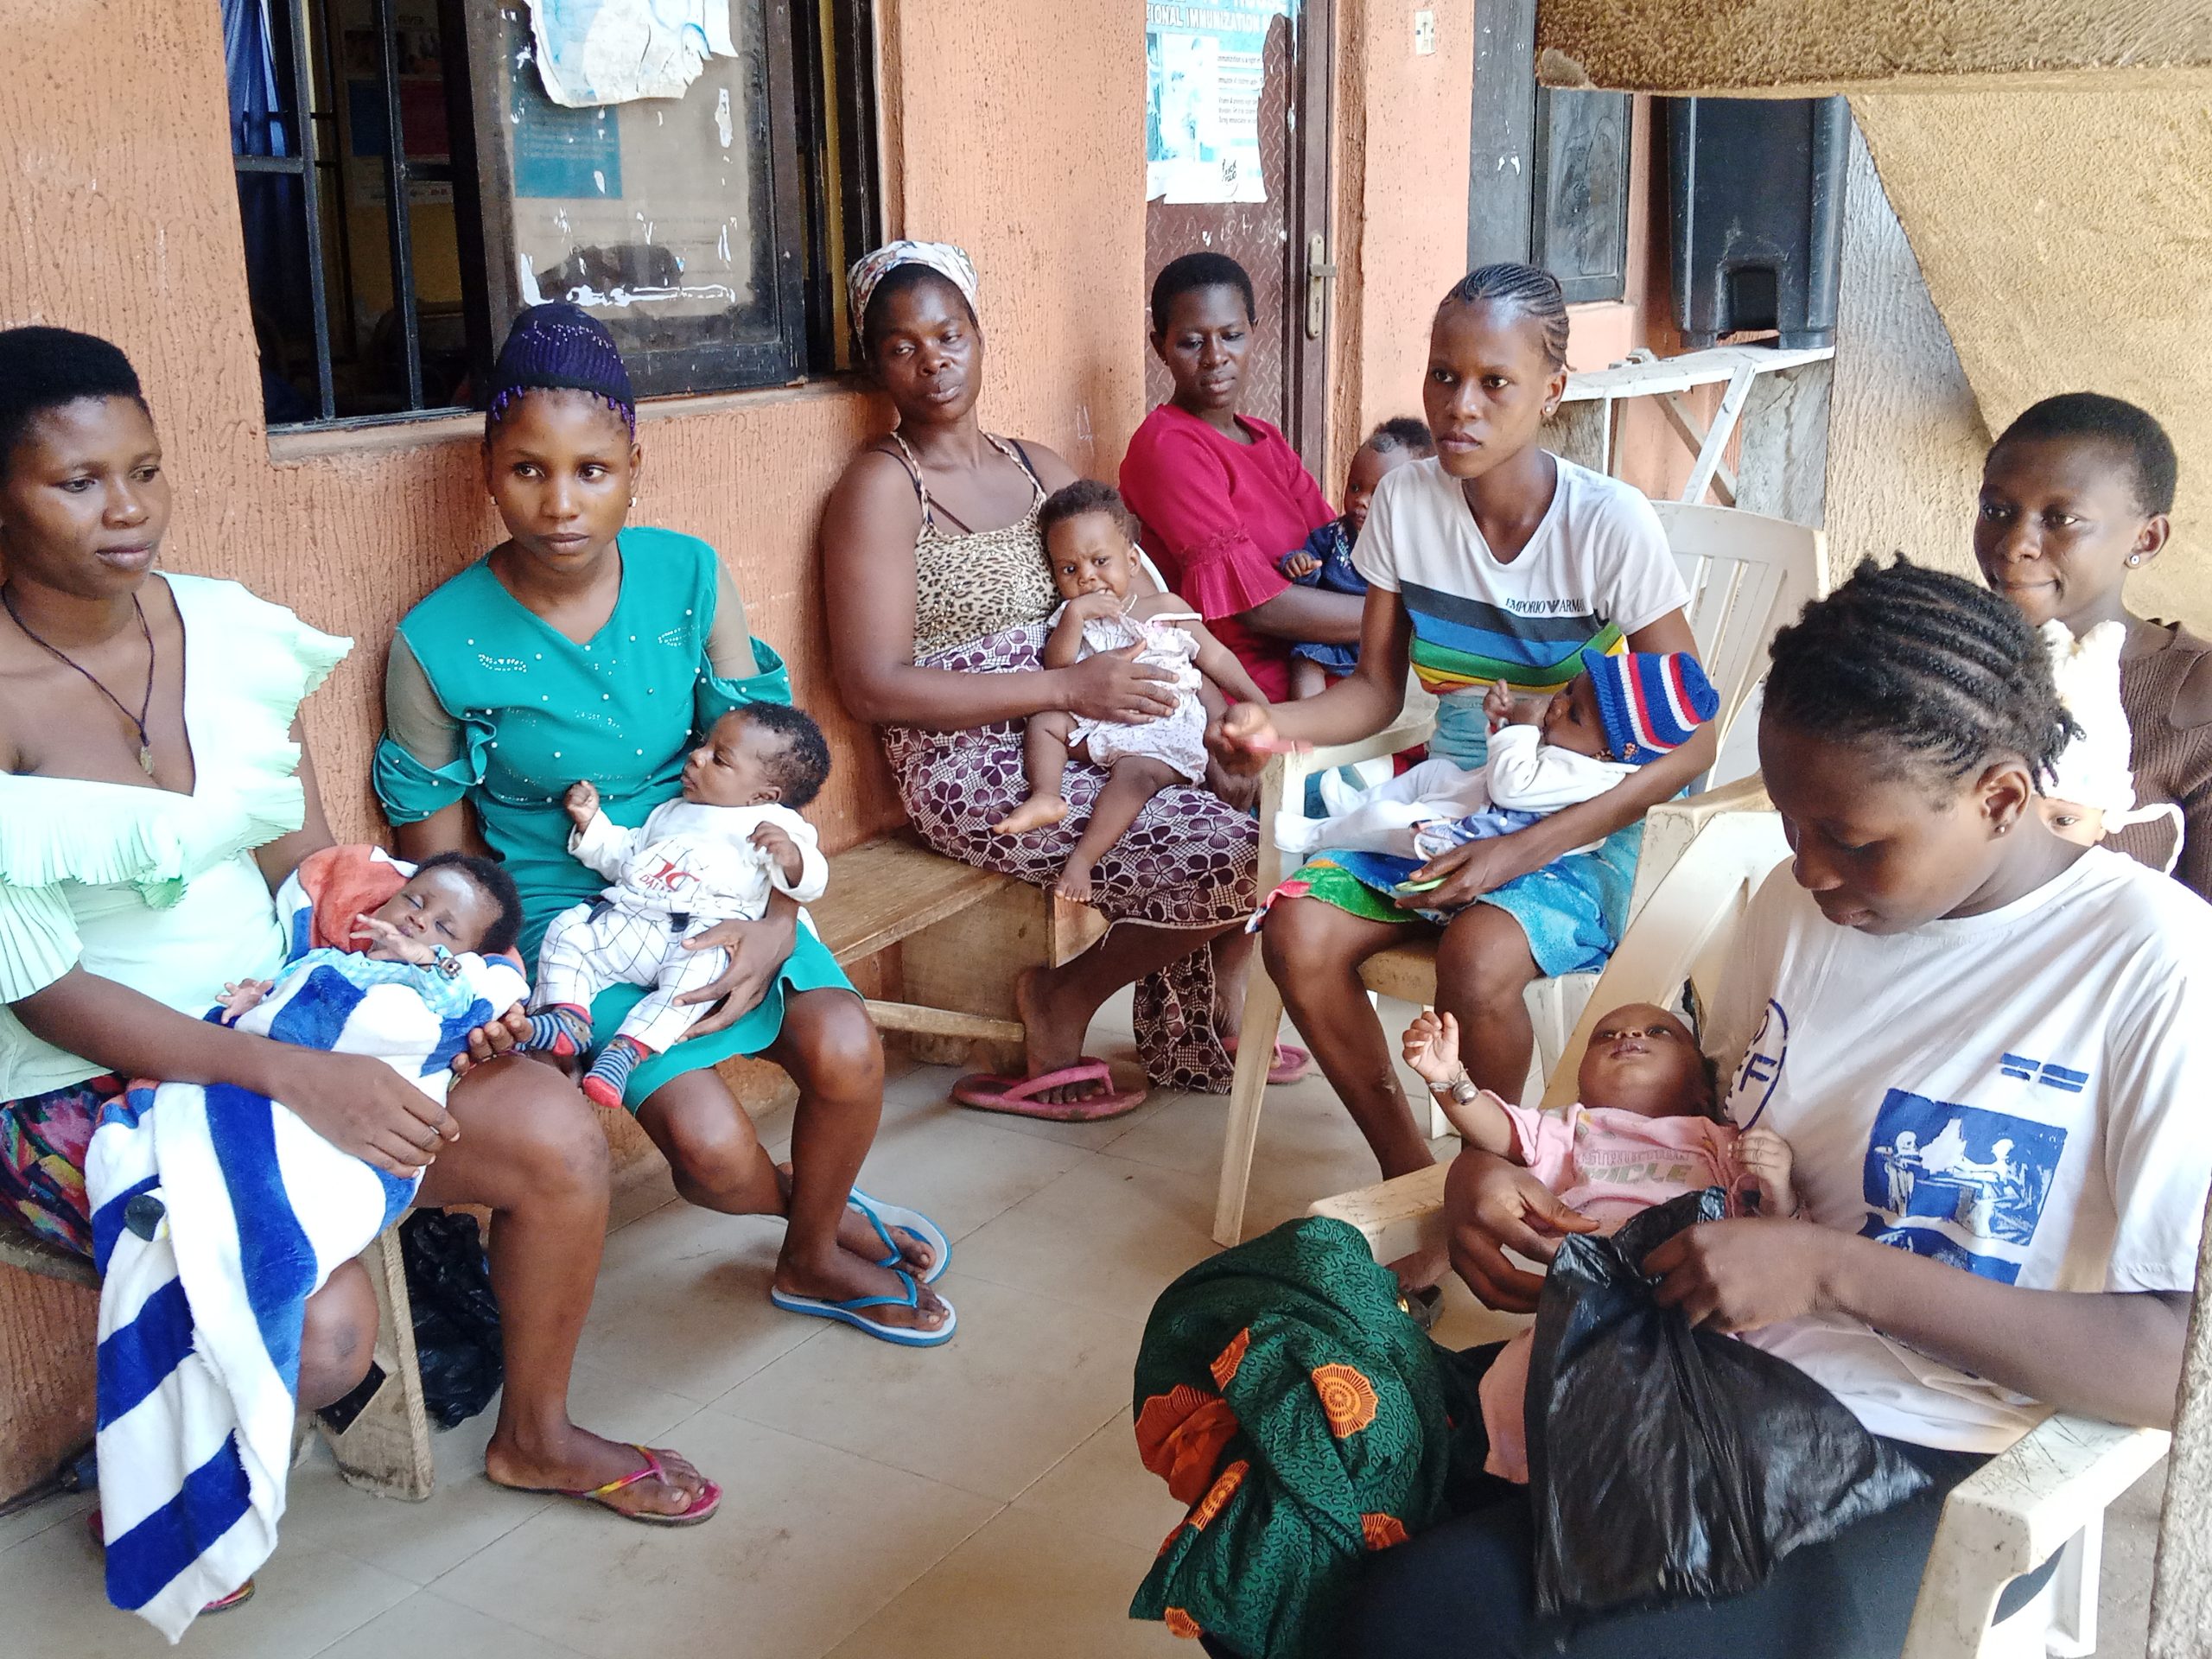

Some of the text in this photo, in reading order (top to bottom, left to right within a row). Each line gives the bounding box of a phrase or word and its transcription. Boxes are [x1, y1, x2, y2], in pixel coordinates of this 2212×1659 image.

[1185, 7, 1260, 32] IMMUNIZATION
[1505, 597, 1586, 613] EMPORIO ARMA
[1581, 1147, 1690, 1166] STRUCTION
